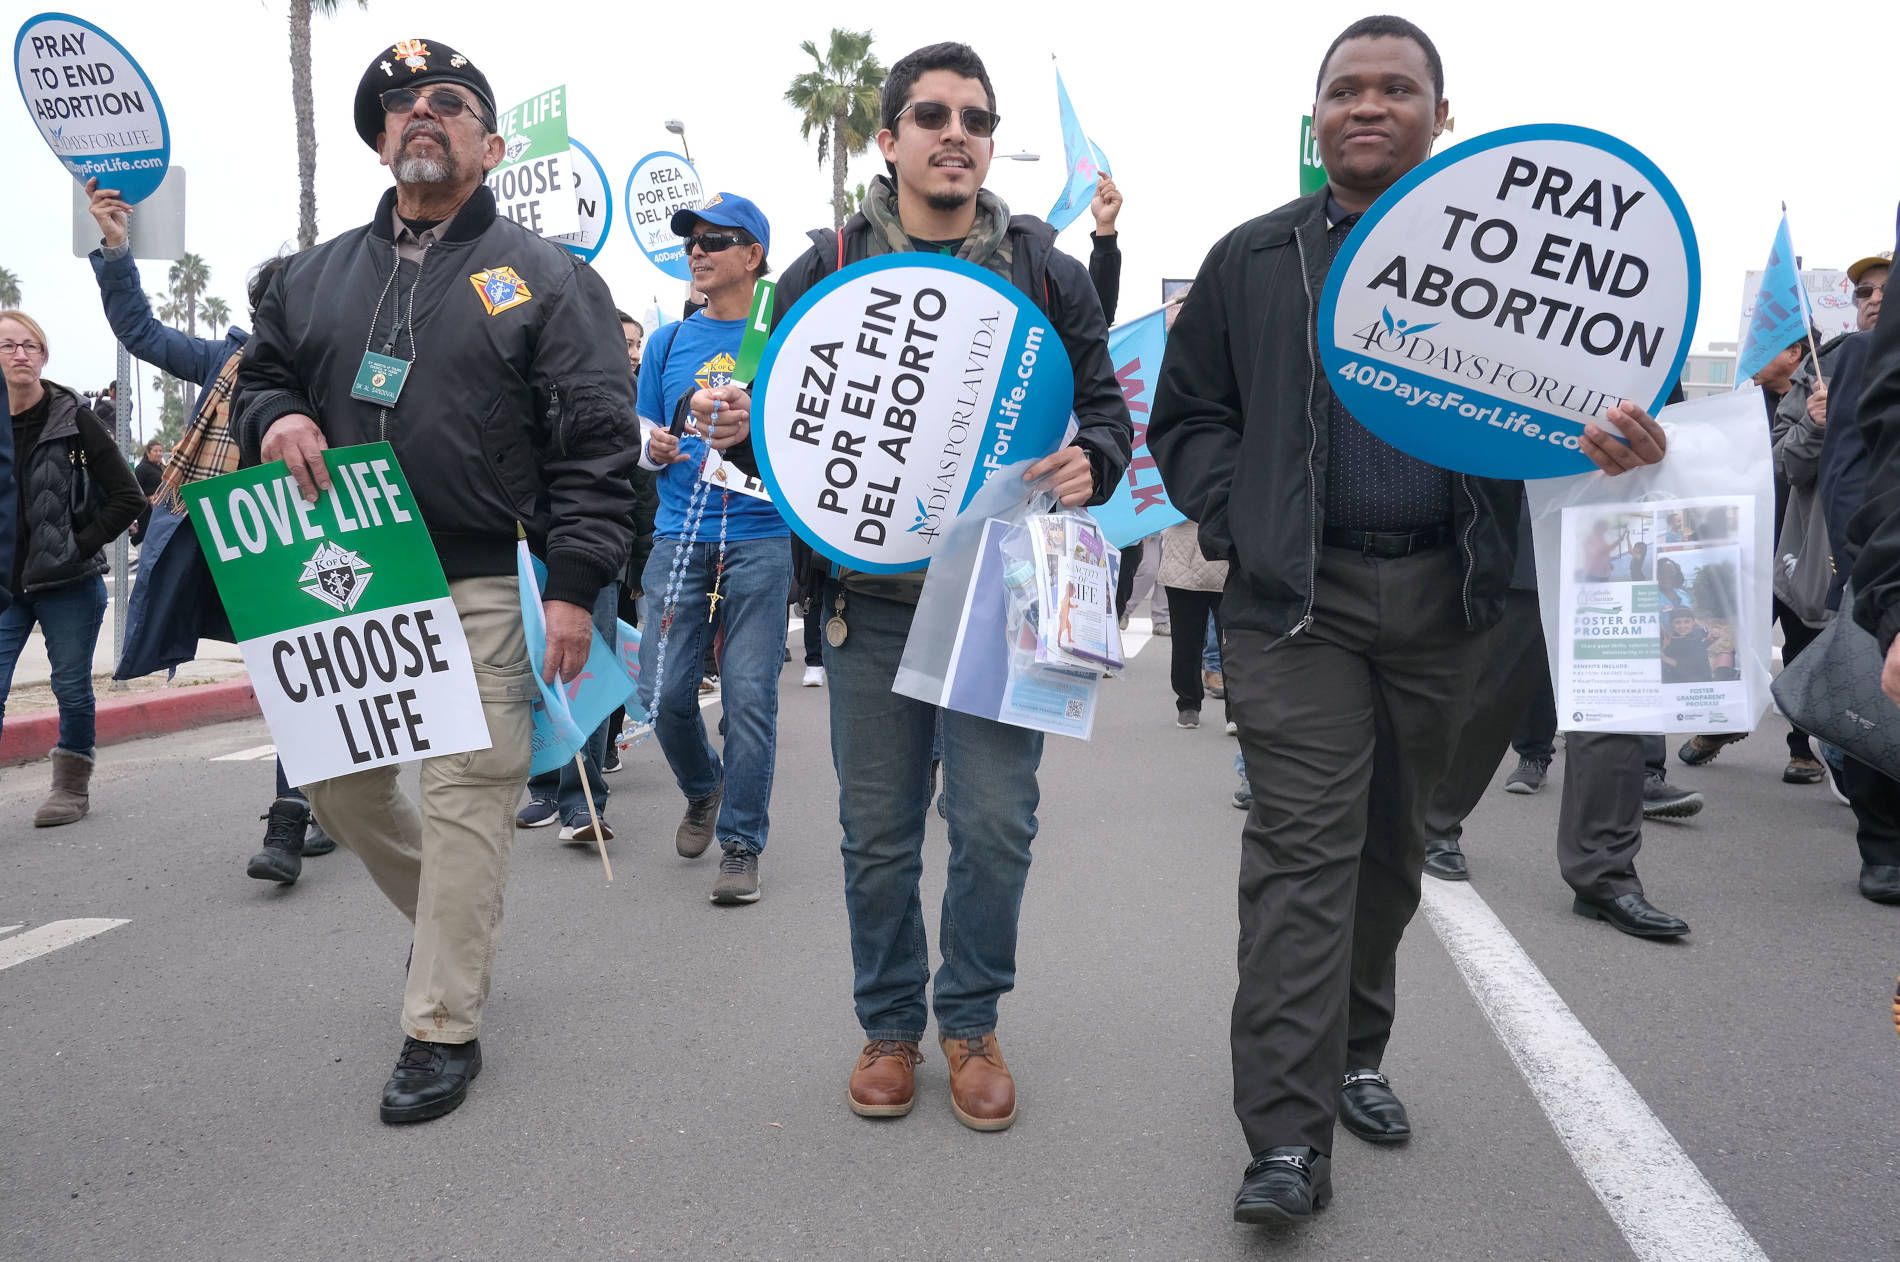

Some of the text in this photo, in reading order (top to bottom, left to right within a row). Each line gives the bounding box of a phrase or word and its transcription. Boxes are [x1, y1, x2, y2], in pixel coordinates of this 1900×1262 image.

[31, 32, 87, 59] PRAY
[30, 62, 115, 90] TO END
[34, 90, 145, 120] ABORTION
[523, 89, 561, 129] LIFE
[489, 158, 561, 202] HOOSE
[638, 182, 699, 206] POR EL FIN
[650, 167, 683, 184] REZA
[1496, 156, 1646, 231] PRAY
[636, 208, 662, 225] DEL
[1441, 206, 1650, 299] TO END
[1366, 255, 1665, 368] ABORTION
[710, 363, 718, 371] K
[1406, 337, 1489, 381] DAYS
[1488, 362, 1560, 401] FOR
[789, 340, 844, 446] REZA
[817, 287, 902, 514] POR EL FIN
[958, 377, 982, 408] LA
[1338, 360, 1584, 454] 40DaysForLife.co
[853, 287, 947, 546] DEL ABORTO
[944, 410, 974, 456] POR
[199, 459, 412, 562] LOVE LIFE
[315, 554, 350, 570] K OF C
[1073, 583, 1098, 605] IFE
[1574, 616, 1624, 626] FOSTER
[1574, 626, 1642, 636] PROGRAM
[272, 609, 449, 703] CHOOSE
[335, 689, 431, 765] LIFE
